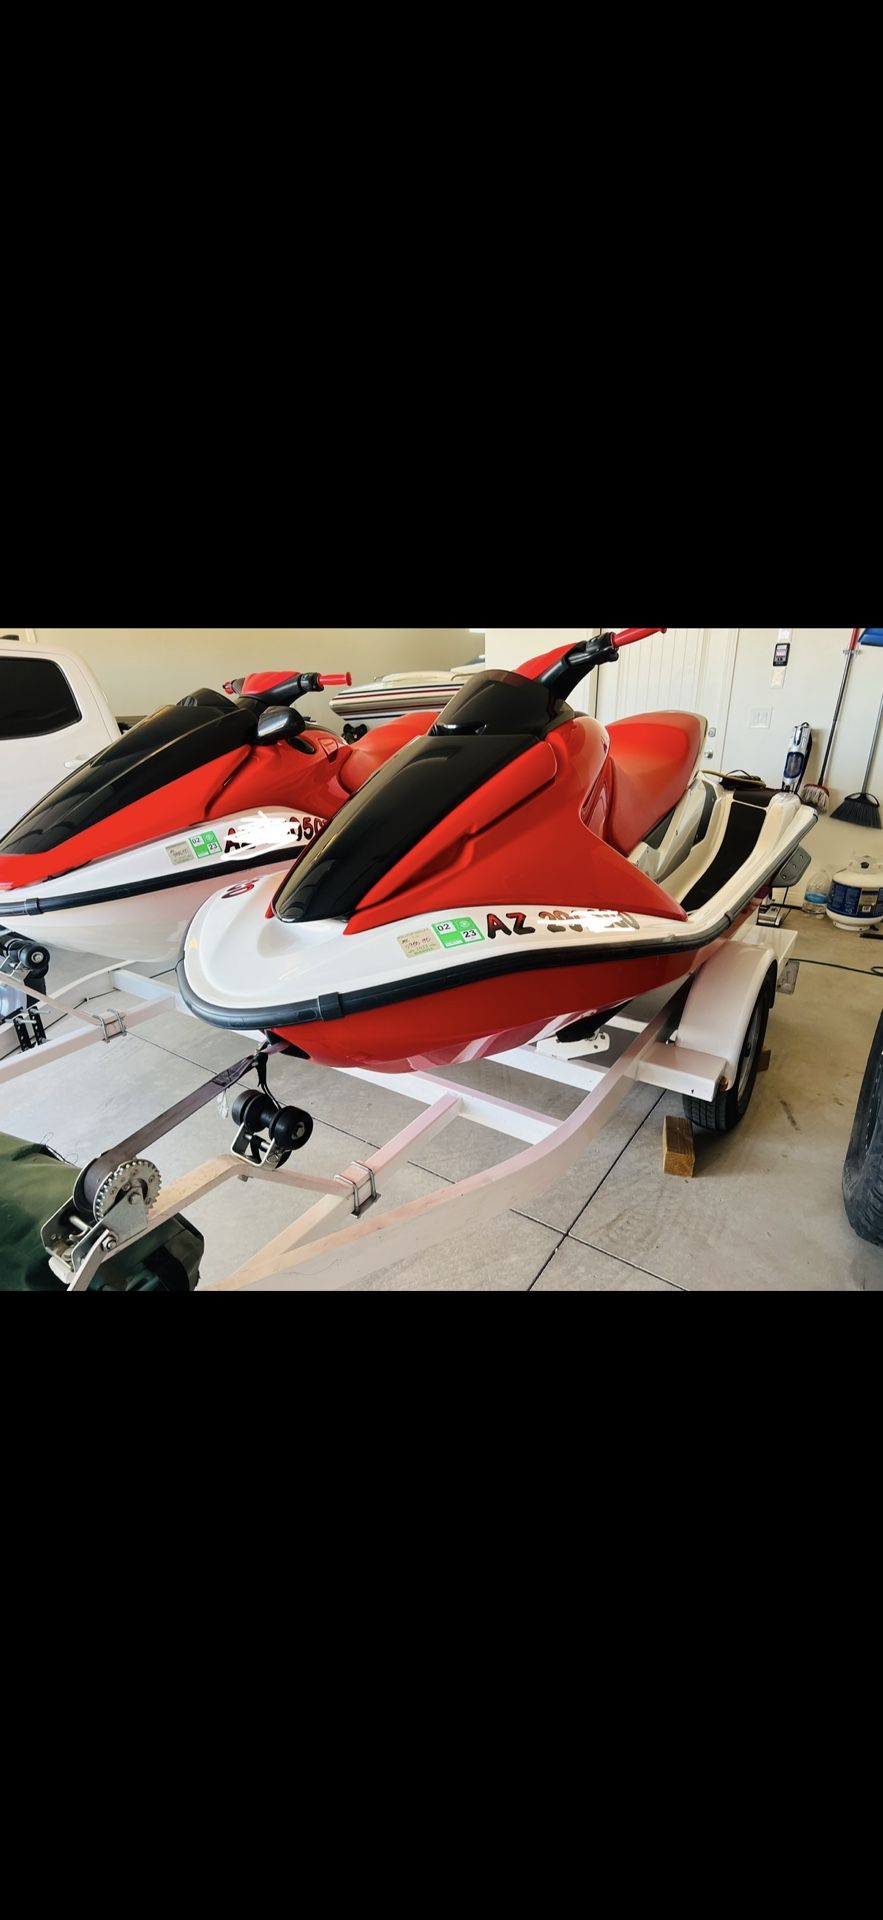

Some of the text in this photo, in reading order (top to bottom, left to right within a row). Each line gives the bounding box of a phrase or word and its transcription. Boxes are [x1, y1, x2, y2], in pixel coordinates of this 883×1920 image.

[437, 923, 451, 931] 02
[487, 912, 536, 939] AZ
[463, 929, 477, 938] 23
